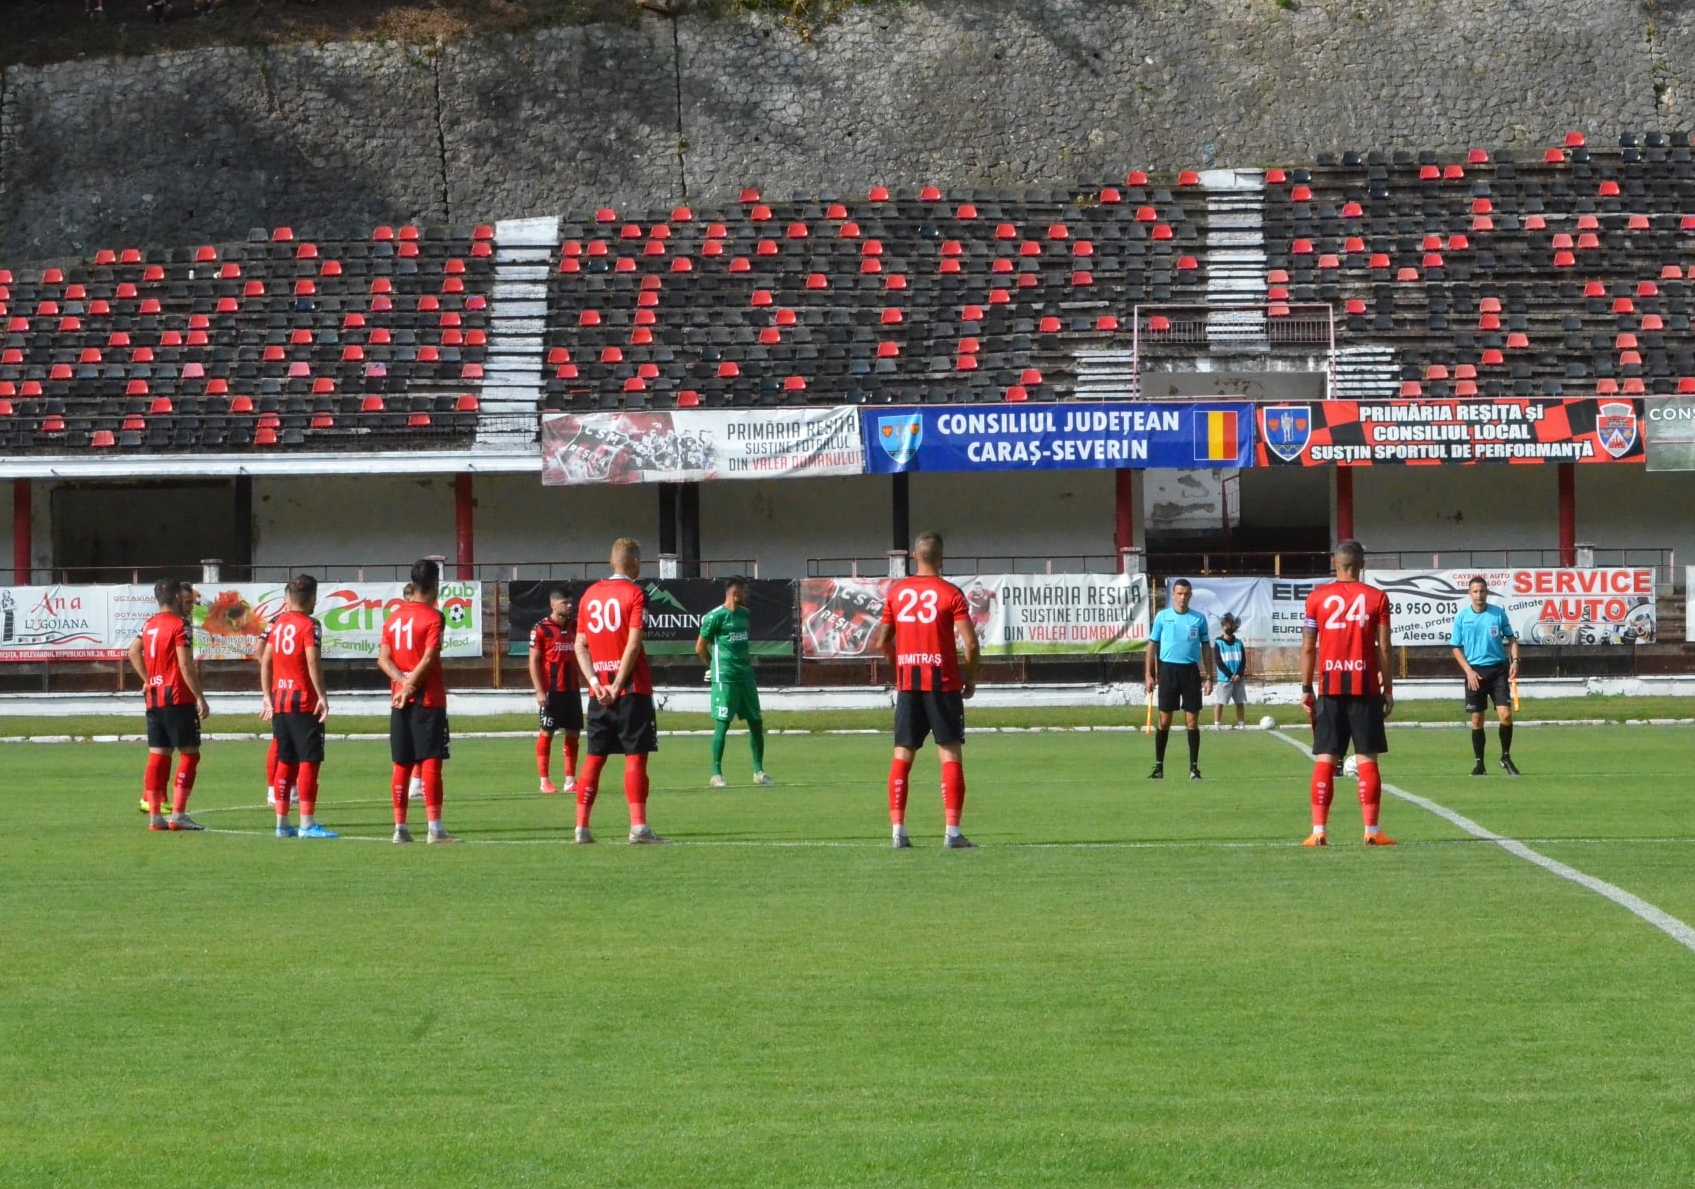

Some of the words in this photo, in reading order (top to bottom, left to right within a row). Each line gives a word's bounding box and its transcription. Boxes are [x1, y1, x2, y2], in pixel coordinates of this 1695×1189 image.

[1359, 402, 1454, 422] PRIMĂRIA
[1649, 407, 1695, 421] CON
[727, 419, 801, 440] PRIMĂRIA
[937, 412, 1057, 435] CONSILIUL
[1064, 411, 1180, 436] JUDEȚEAN
[1373, 425, 1471, 442] CONSILIUL
[1473, 423, 1531, 440] LOCAL
[728, 457, 748, 472] DIN
[752, 456, 788, 471] VALEA
[792, 450, 860, 470] DOMANULUI
[967, 439, 1148, 466] CARAȘ-SEVERIN
[1374, 443, 1448, 460] SPORTUL
[1451, 443, 1472, 459] DE
[1474, 440, 1595, 461] PERFORMANȚĂ
[1489, 572, 1511, 580] AUTO
[1512, 570, 1651, 594] SERVICE
[440, 581, 475, 600] pub
[1002, 583, 1081, 606] PRIMĂRIA
[30, 591, 82, 617] Ana
[896, 588, 938, 624] 23
[1076, 606, 1135, 623] FOTBALUL
[1323, 593, 1370, 630] 24
[1406, 602, 1432, 615] 950
[1436, 602, 1458, 615] 013
[1508, 599, 1544, 612] calitate
[1539, 597, 1628, 622] AUTO
[24, 618, 89, 631] LUGOJANA
[586, 597, 622, 634] 30
[146, 627, 159, 658] 7
[273, 624, 297, 656] 18
[389, 617, 414, 650] 11
[1004, 625, 1024, 641] DIN
[1028, 625, 1067, 641] VALEA
[1071, 623, 1145, 641] DOMANULUI
[1402, 631, 1436, 641] Aleea
[333, 637, 376, 655] Family
[718, 706, 728, 718] 12
